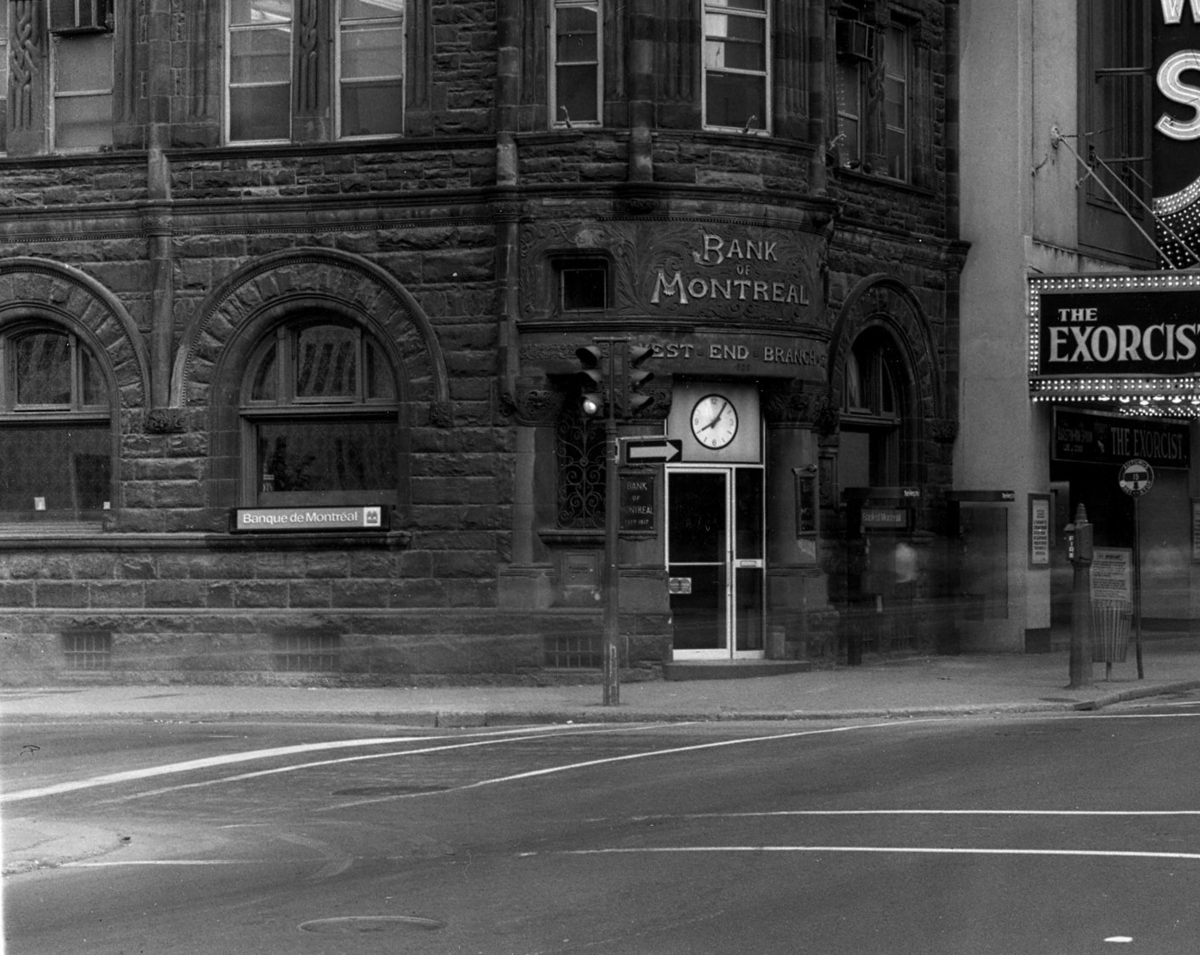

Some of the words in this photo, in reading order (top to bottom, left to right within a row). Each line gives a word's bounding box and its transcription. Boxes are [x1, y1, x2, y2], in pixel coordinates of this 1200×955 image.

[692, 234, 778, 266] BANK
[736, 265, 751, 275] OF
[650, 270, 809, 305] MONTREAL
[1058, 307, 1098, 322] THE
[709, 345, 749, 360] END
[763, 346, 816, 365] BRANCH
[1110, 426, 1130, 456] THE
[1133, 428, 1187, 460] EXORCIST.
[626, 481, 648, 491] BANK
[243, 513, 288, 525] Banque
[289, 512, 304, 523] de
[305, 511, 358, 523] Montréal
